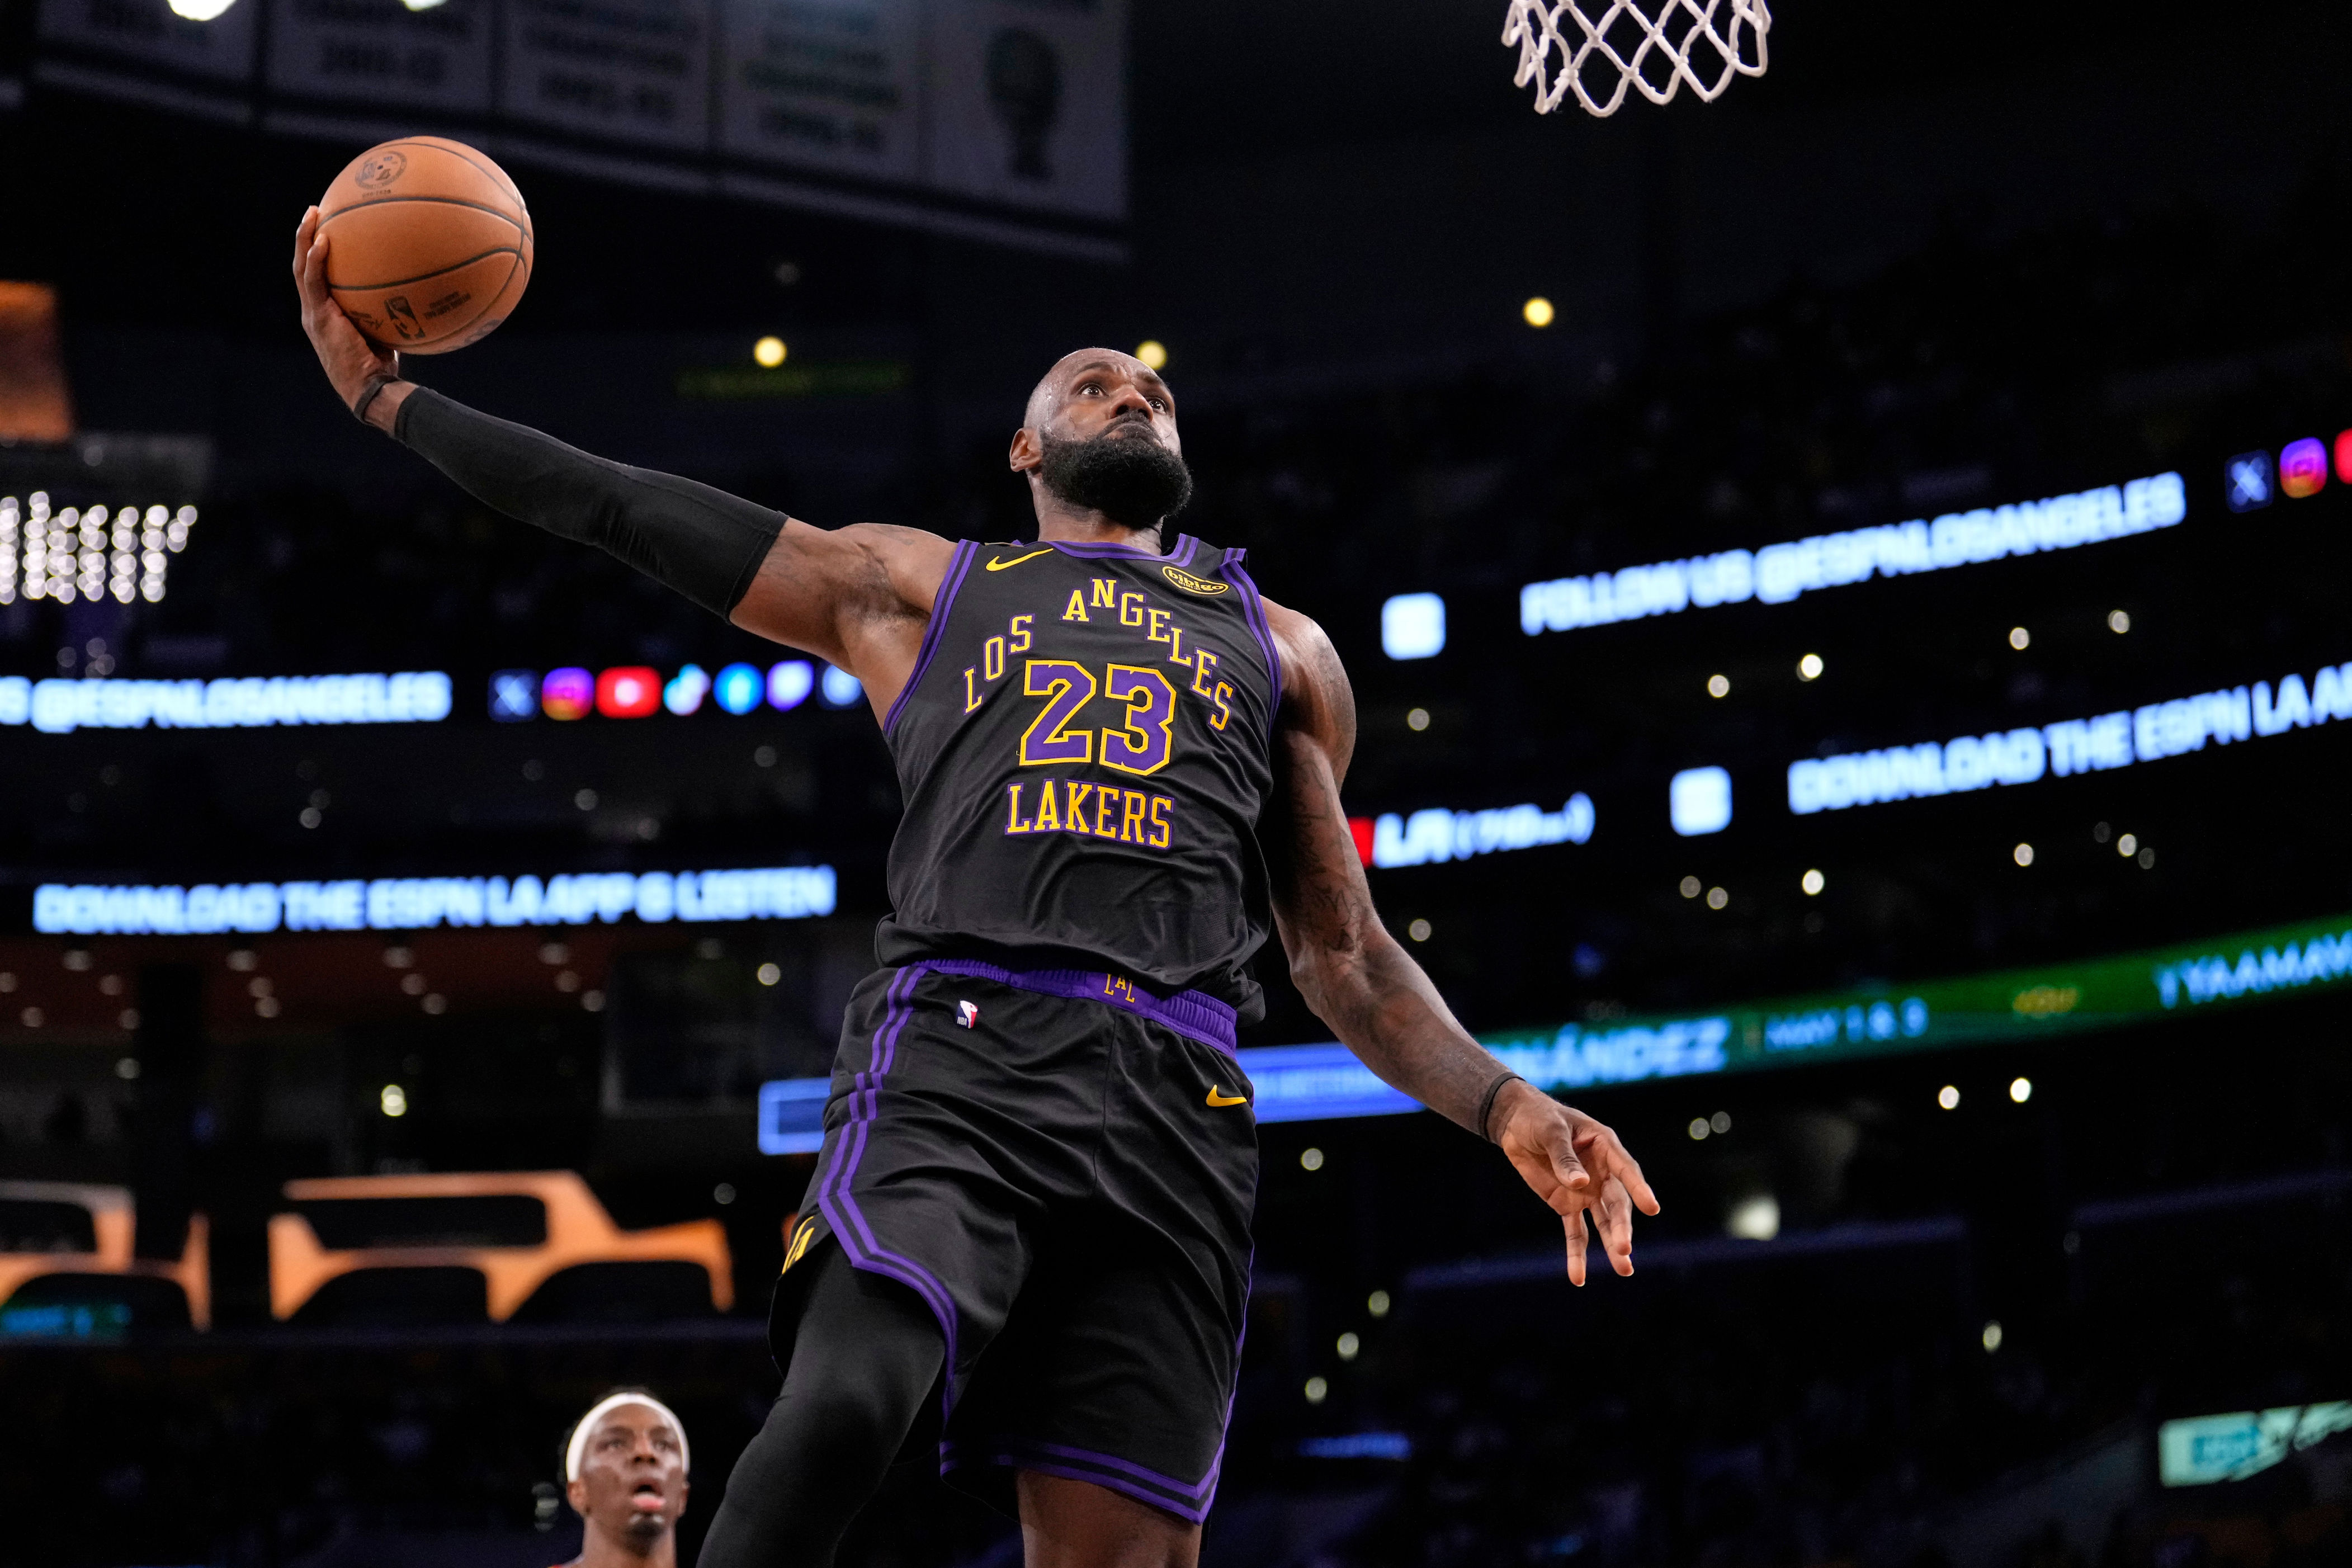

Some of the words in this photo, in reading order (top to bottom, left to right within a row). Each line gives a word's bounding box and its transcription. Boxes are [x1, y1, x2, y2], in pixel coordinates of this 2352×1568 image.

[1168, 569, 1224, 591] bibigo
[1520, 558, 1688, 635] FOLLOW
[1689, 549, 1754, 608] US
[1754, 470, 2185, 605] @ESPNLOSANGELES
[963, 613, 1035, 716] LOS
[1062, 578, 1233, 732] ANGELES
[31, 670, 452, 734] @ESPNLOSANGELES
[1018, 659, 1177, 776] 23
[1789, 728, 2047, 815] DOWNLOAD
[2043, 711, 2133, 777] THE
[2133, 686, 2251, 762] ESPN
[2251, 674, 2313, 736] LA
[1005, 778, 1174, 850] LAKERS
[34, 884, 278, 934] DOWNLOAD
[281, 879, 365, 931] THE
[366, 876, 485, 928] ESPN
[487, 875, 544, 927] LA
[674, 865, 837, 922] LISTEN
[957, 1016, 967, 1026] NBA
[1104, 974, 1135, 1003] LAL
